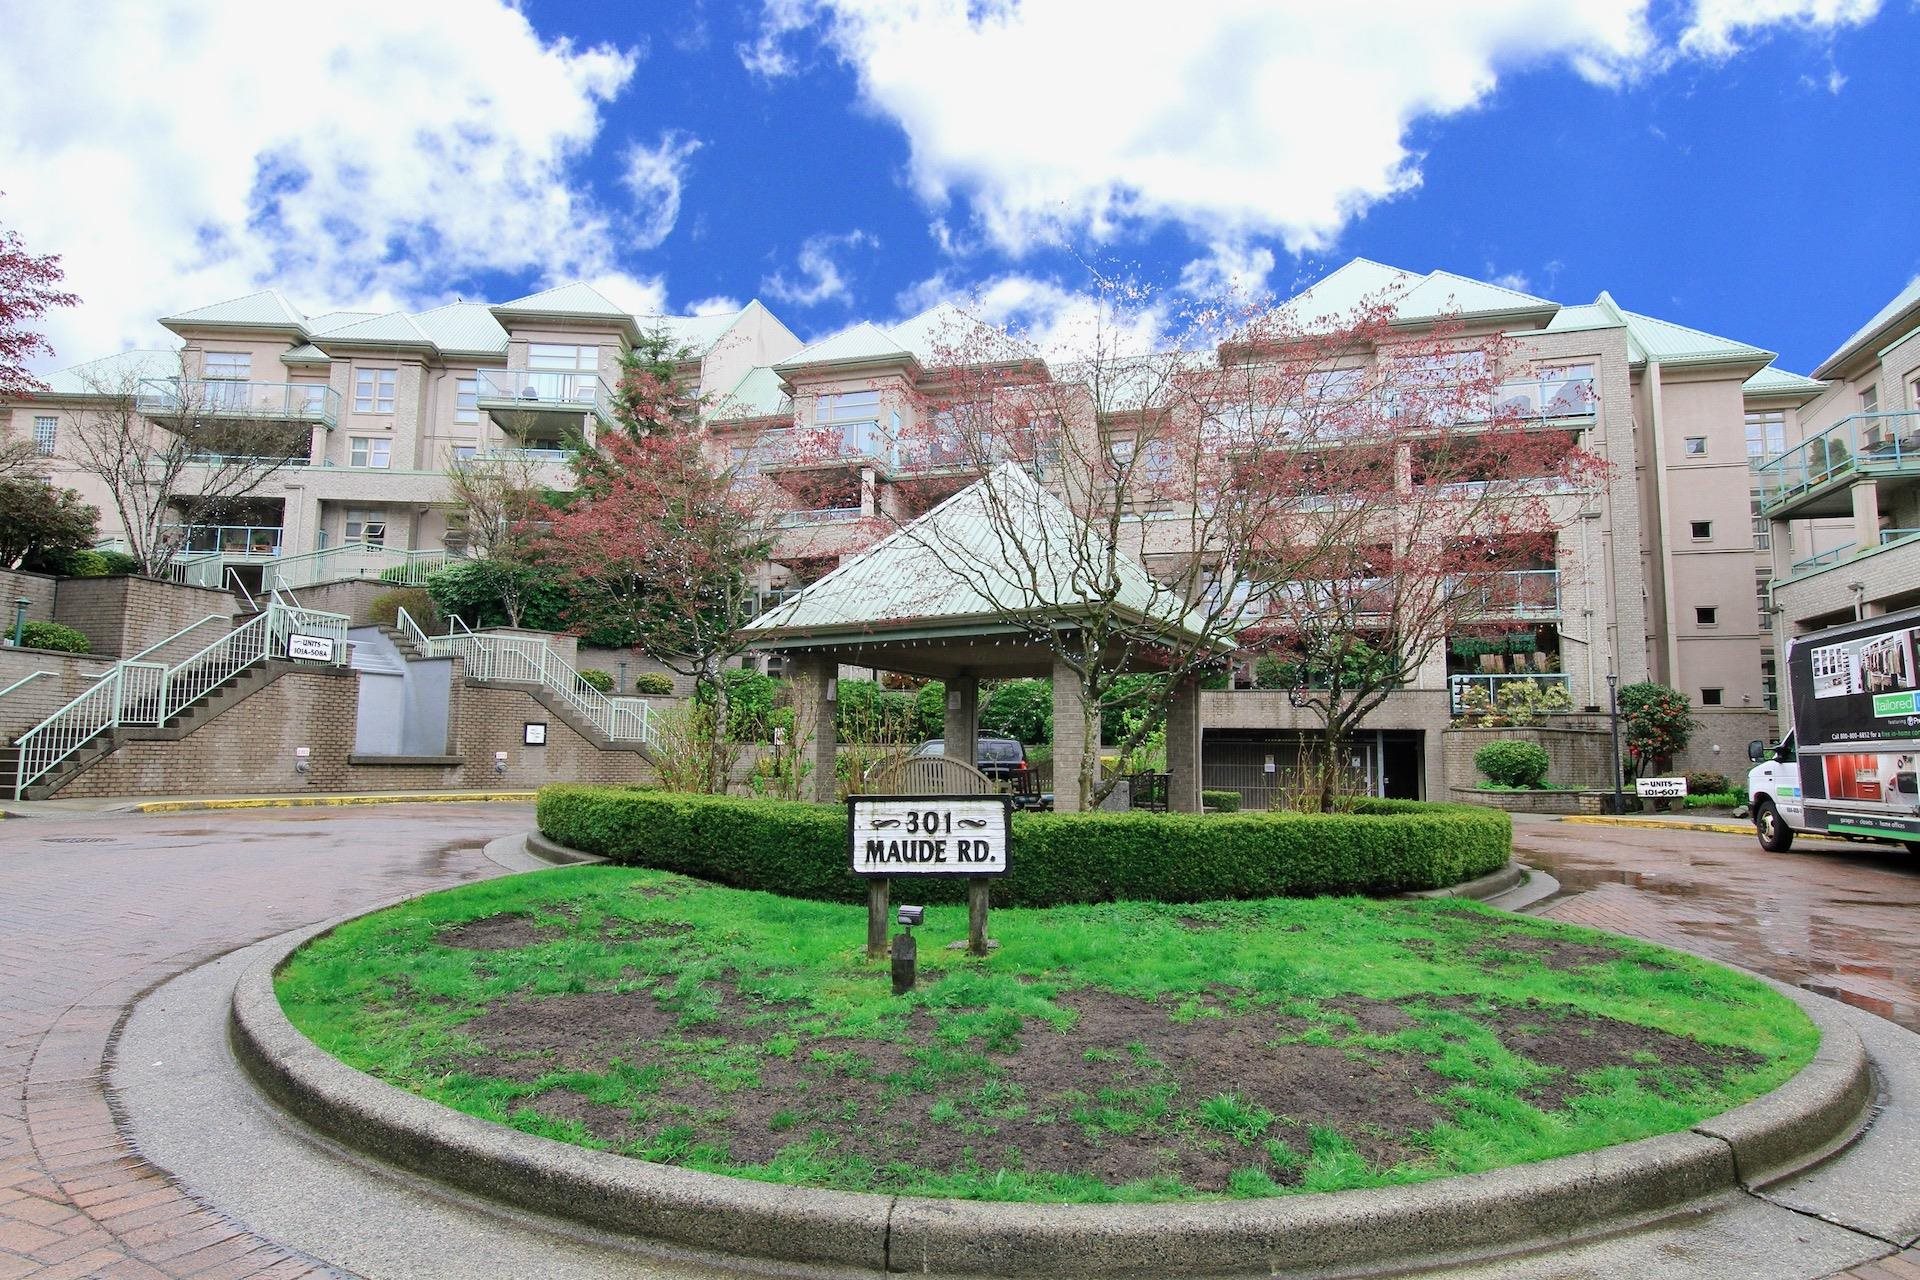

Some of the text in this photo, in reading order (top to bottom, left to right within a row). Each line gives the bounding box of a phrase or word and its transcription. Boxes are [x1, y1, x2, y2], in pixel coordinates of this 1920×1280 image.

[302, 639, 322, 648] UNITS
[1877, 697, 1912, 711] tailored
[906, 811, 952, 834] 301
[865, 840, 996, 863] MAUDE RD.
